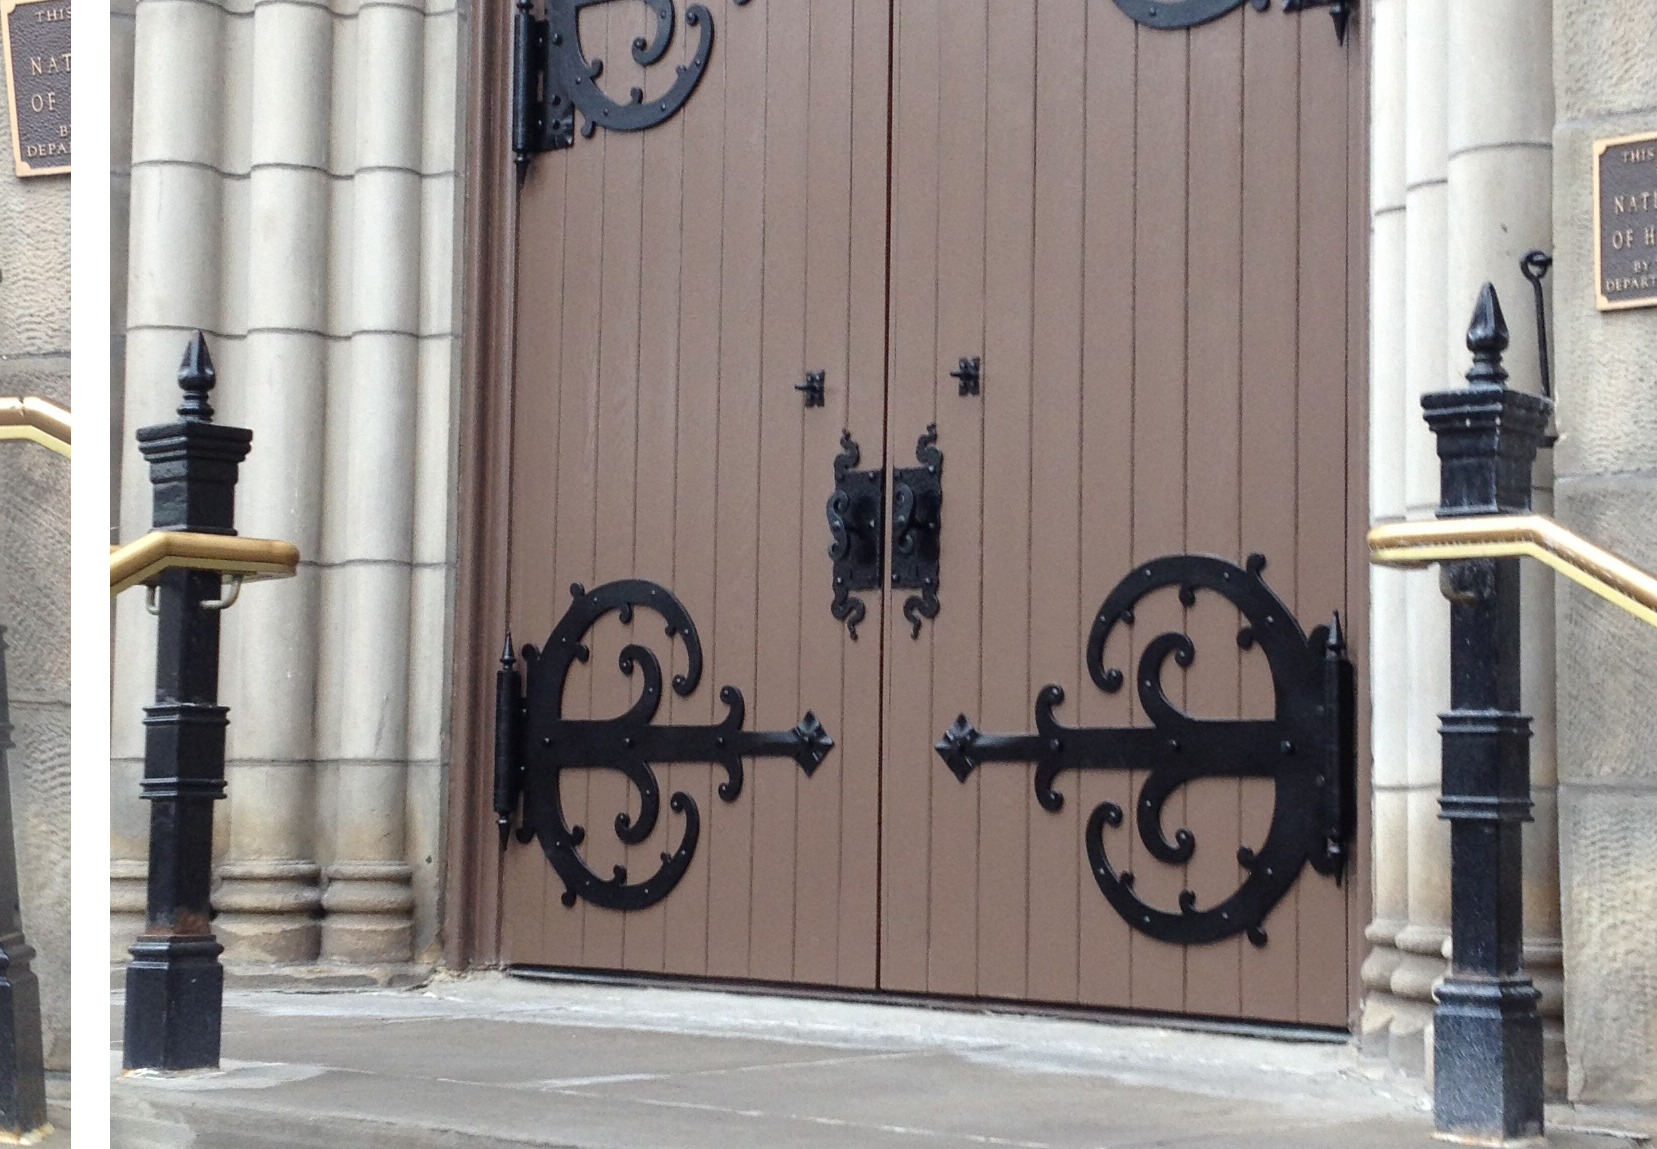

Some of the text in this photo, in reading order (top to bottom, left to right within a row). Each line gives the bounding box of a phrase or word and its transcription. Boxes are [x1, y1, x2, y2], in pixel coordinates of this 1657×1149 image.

[30, 53, 72, 76] NAT
[30, 91, 56, 113] OF
[59, 124, 72, 138] B
[27, 143, 72, 158] DEPA
[1622, 148, 1655, 164] THIS
[1612, 228, 1634, 250] OF
